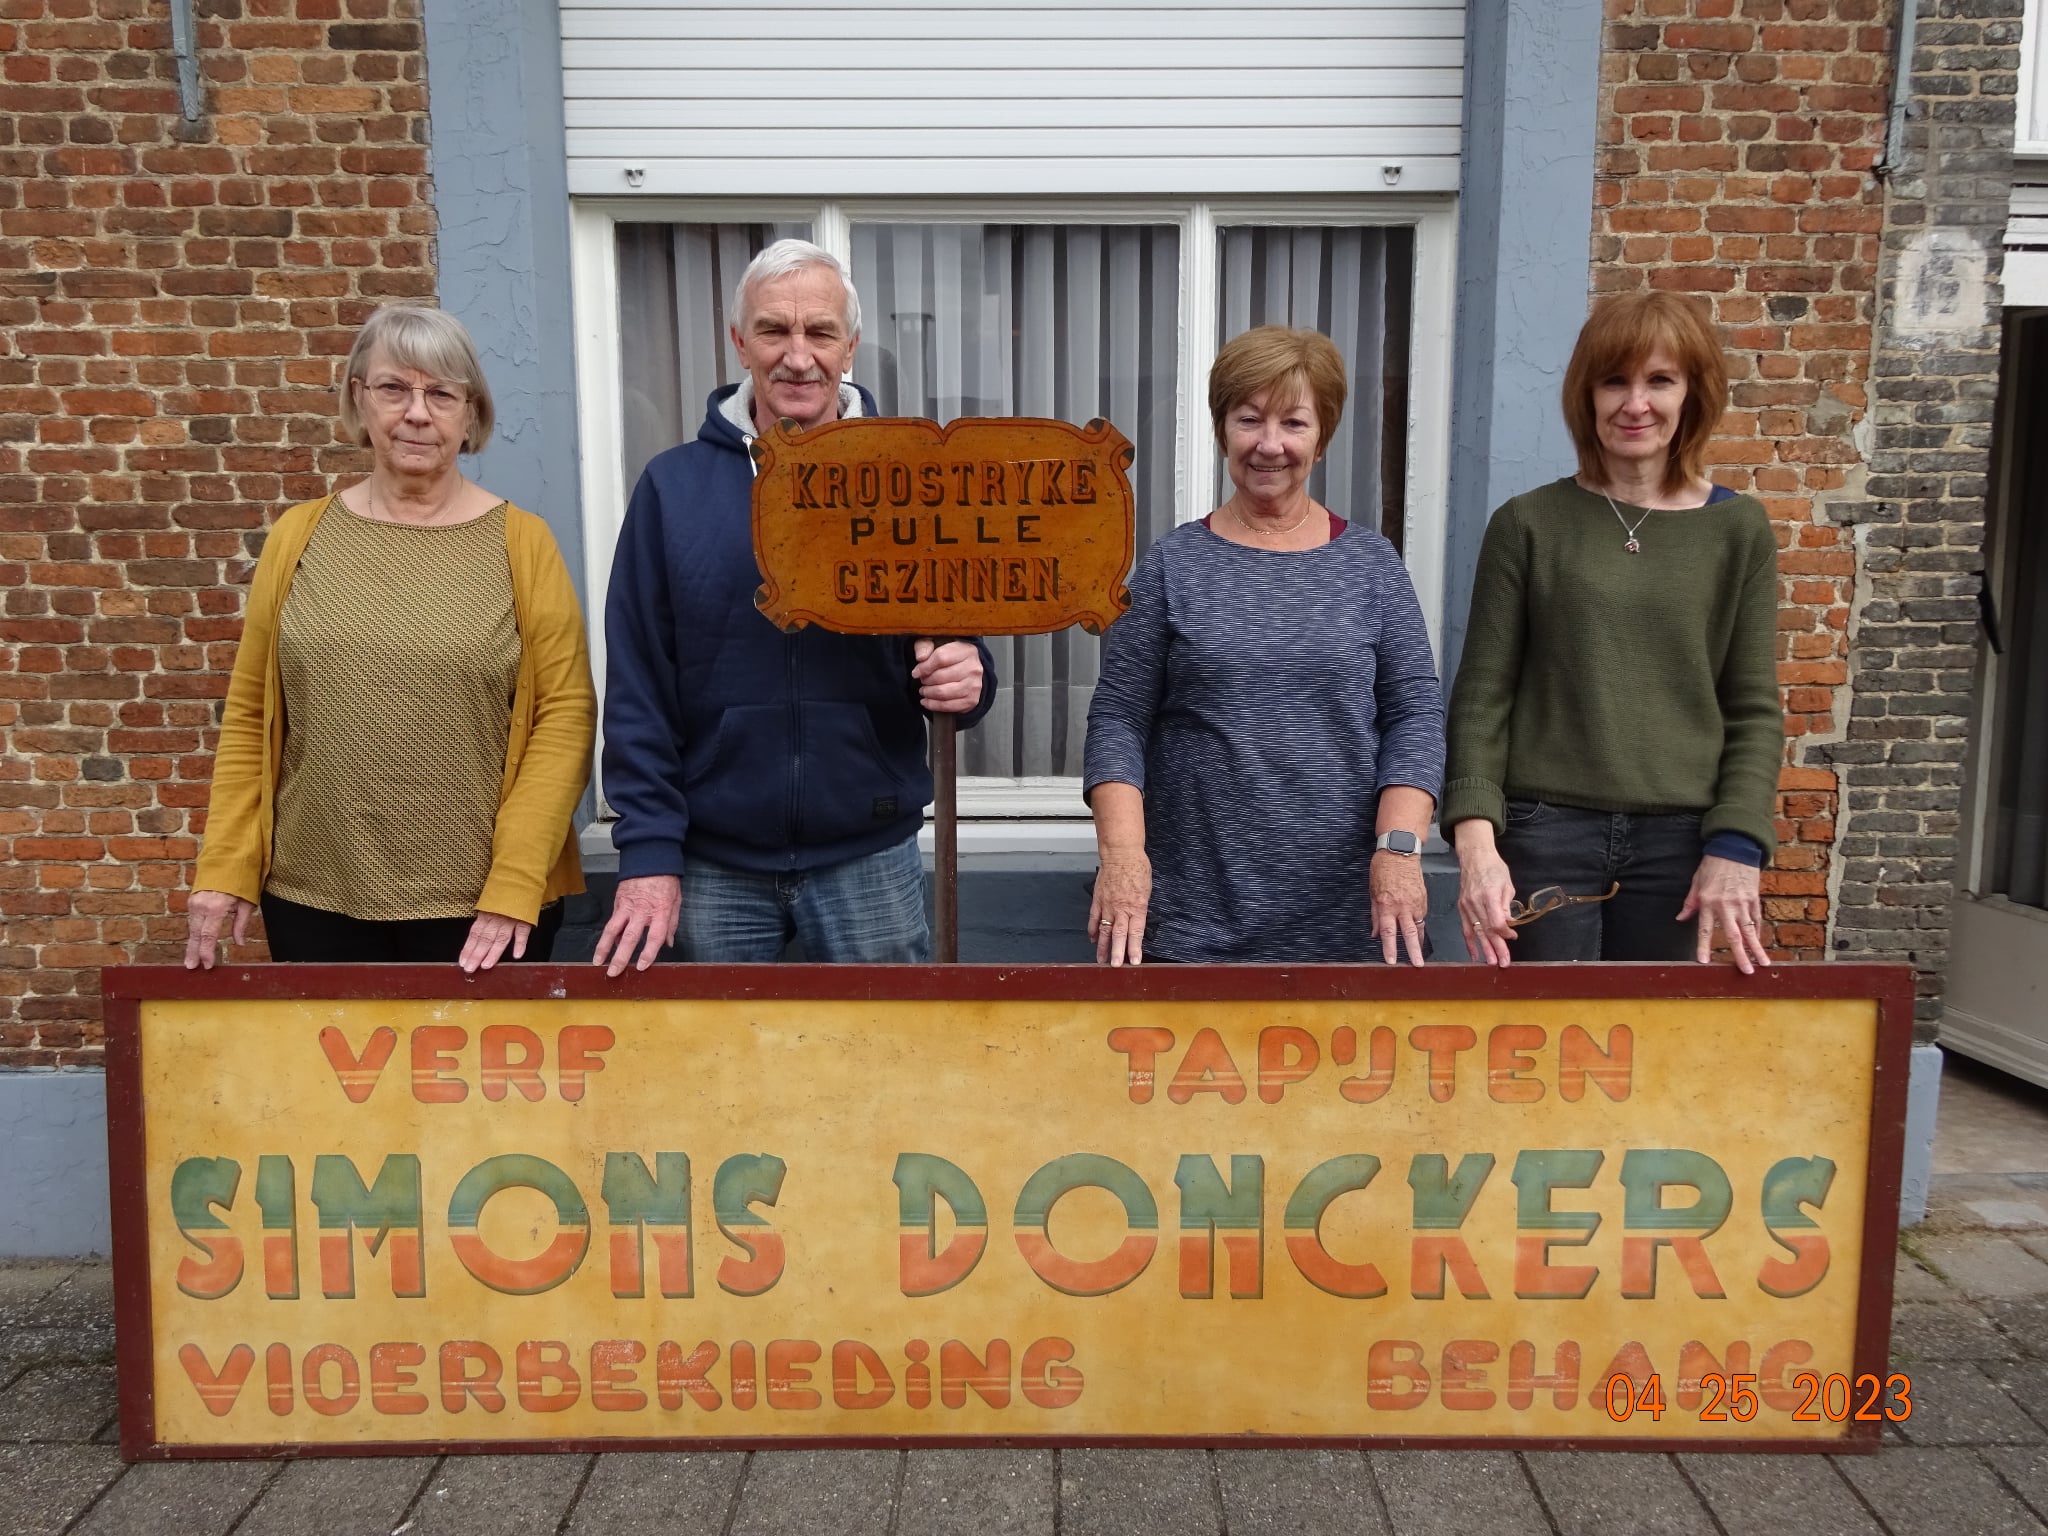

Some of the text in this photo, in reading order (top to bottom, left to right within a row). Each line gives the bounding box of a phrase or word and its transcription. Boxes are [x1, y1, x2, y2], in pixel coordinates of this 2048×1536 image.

[791, 459, 1097, 509] KROOSTRYKE
[850, 515, 1042, 546] PULLE
[833, 557, 1060, 604] GEZINNEN
[318, 1024, 616, 1104] VERF
[170, 1148, 1837, 1300] SIMONS DONCKERS
[1366, 1338, 1819, 1411] BEHANG
